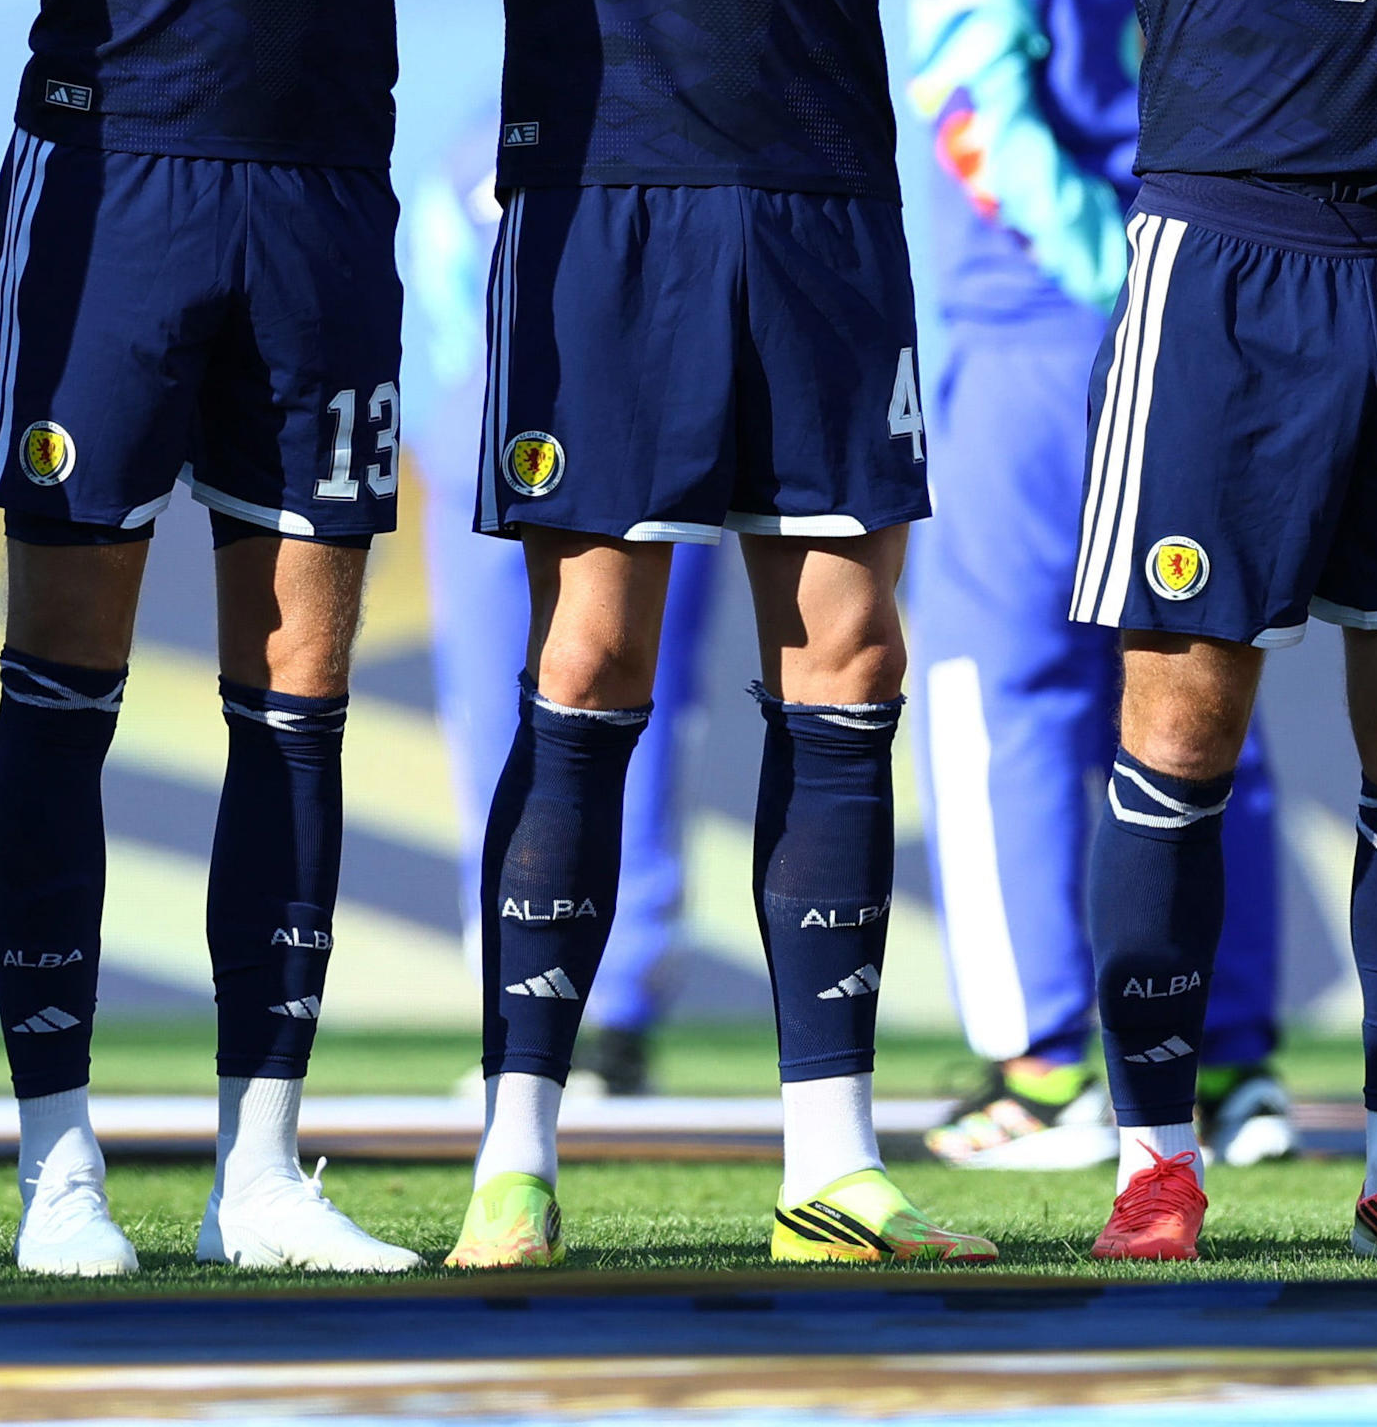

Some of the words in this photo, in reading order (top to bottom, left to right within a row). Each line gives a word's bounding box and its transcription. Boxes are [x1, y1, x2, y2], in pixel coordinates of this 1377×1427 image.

[888, 347, 924, 464] 4
[313, 381, 399, 501] 13
[502, 897, 597, 921] ALBA
[3, 949, 83, 968] ALBA
[1123, 971, 1202, 998] ALBA
